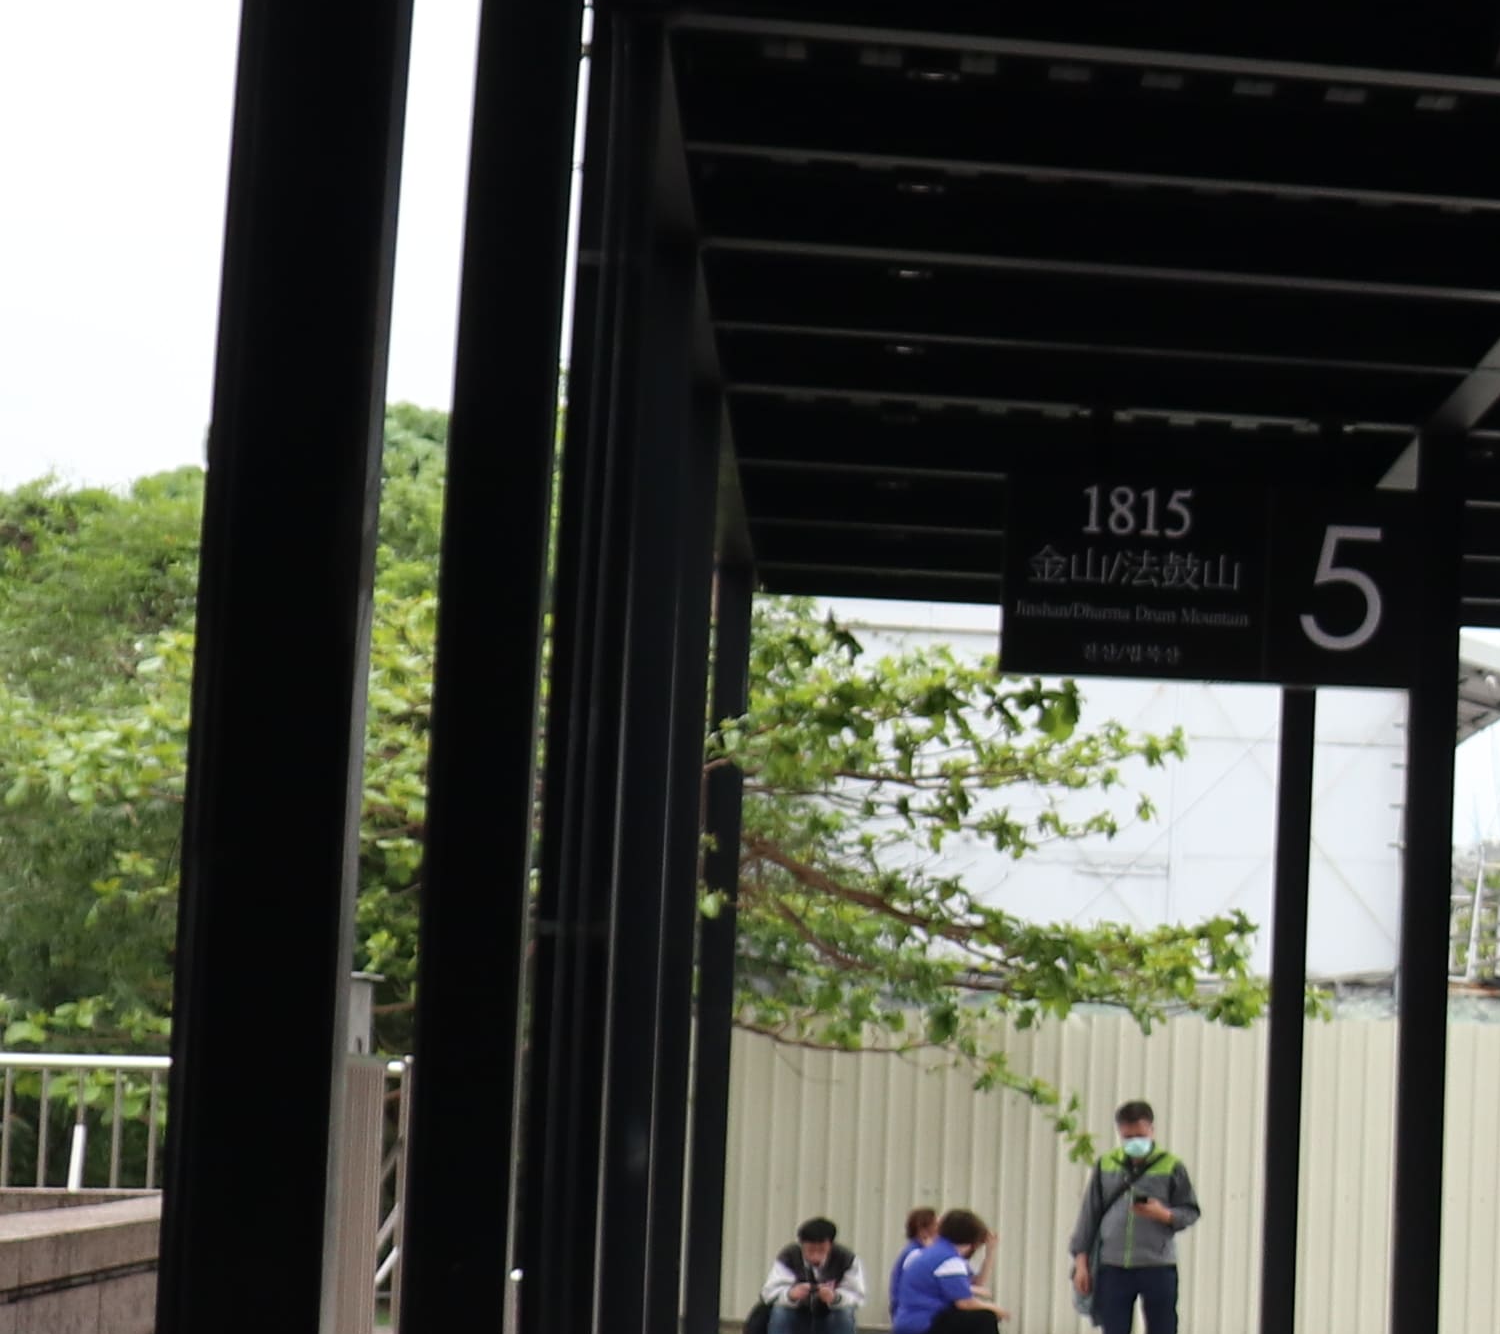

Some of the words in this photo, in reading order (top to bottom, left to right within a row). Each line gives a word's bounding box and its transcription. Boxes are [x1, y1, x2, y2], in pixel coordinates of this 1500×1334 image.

[1082, 485, 1193, 538] 1815
[1027, 544, 1241, 591] 金山/法鼓山
[1300, 525, 1382, 651] 5
[1180, 607, 1249, 628] Mountain
